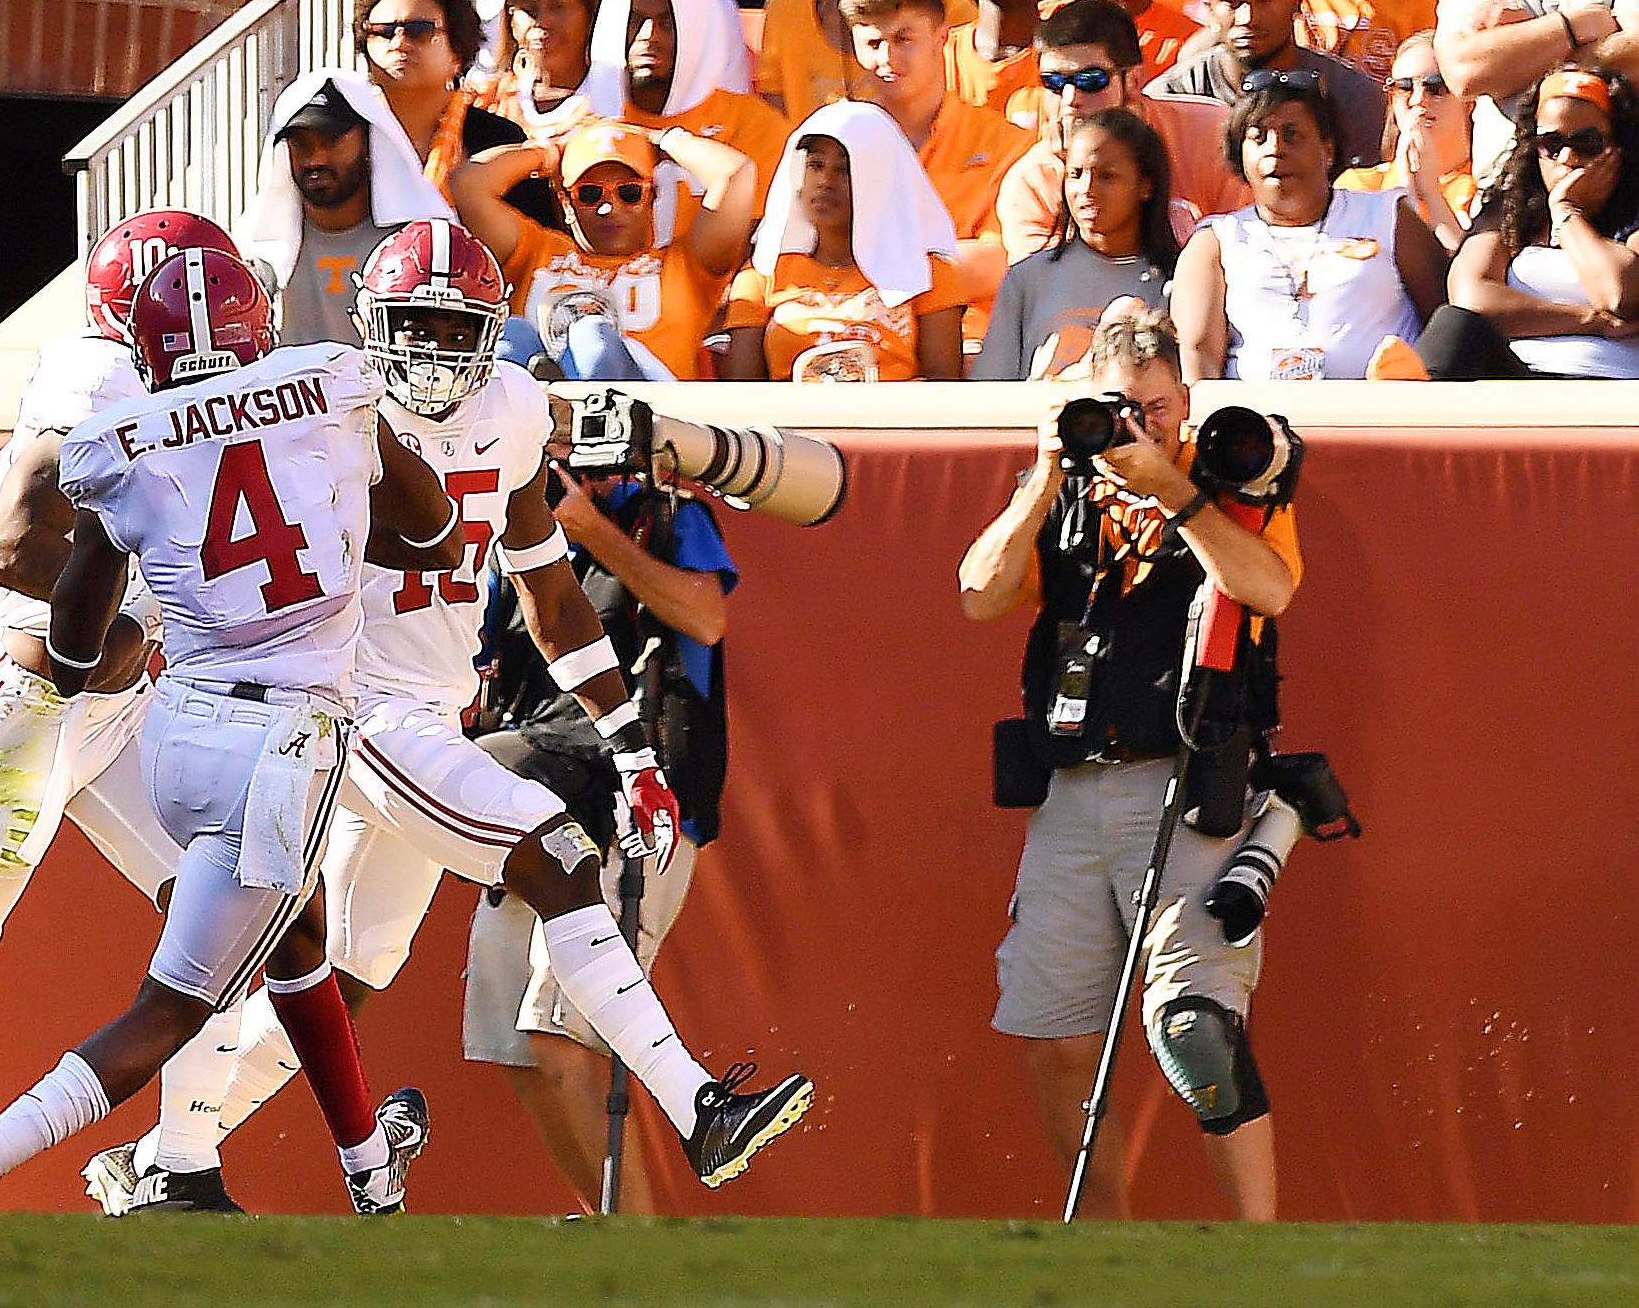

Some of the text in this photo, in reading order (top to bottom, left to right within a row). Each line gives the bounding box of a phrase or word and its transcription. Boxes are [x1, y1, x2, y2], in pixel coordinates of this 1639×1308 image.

[129, 237, 167, 286] 10
[316, 254, 356, 294] T
[163, 377, 328, 448] JACKSON
[200, 439, 326, 613] 4
